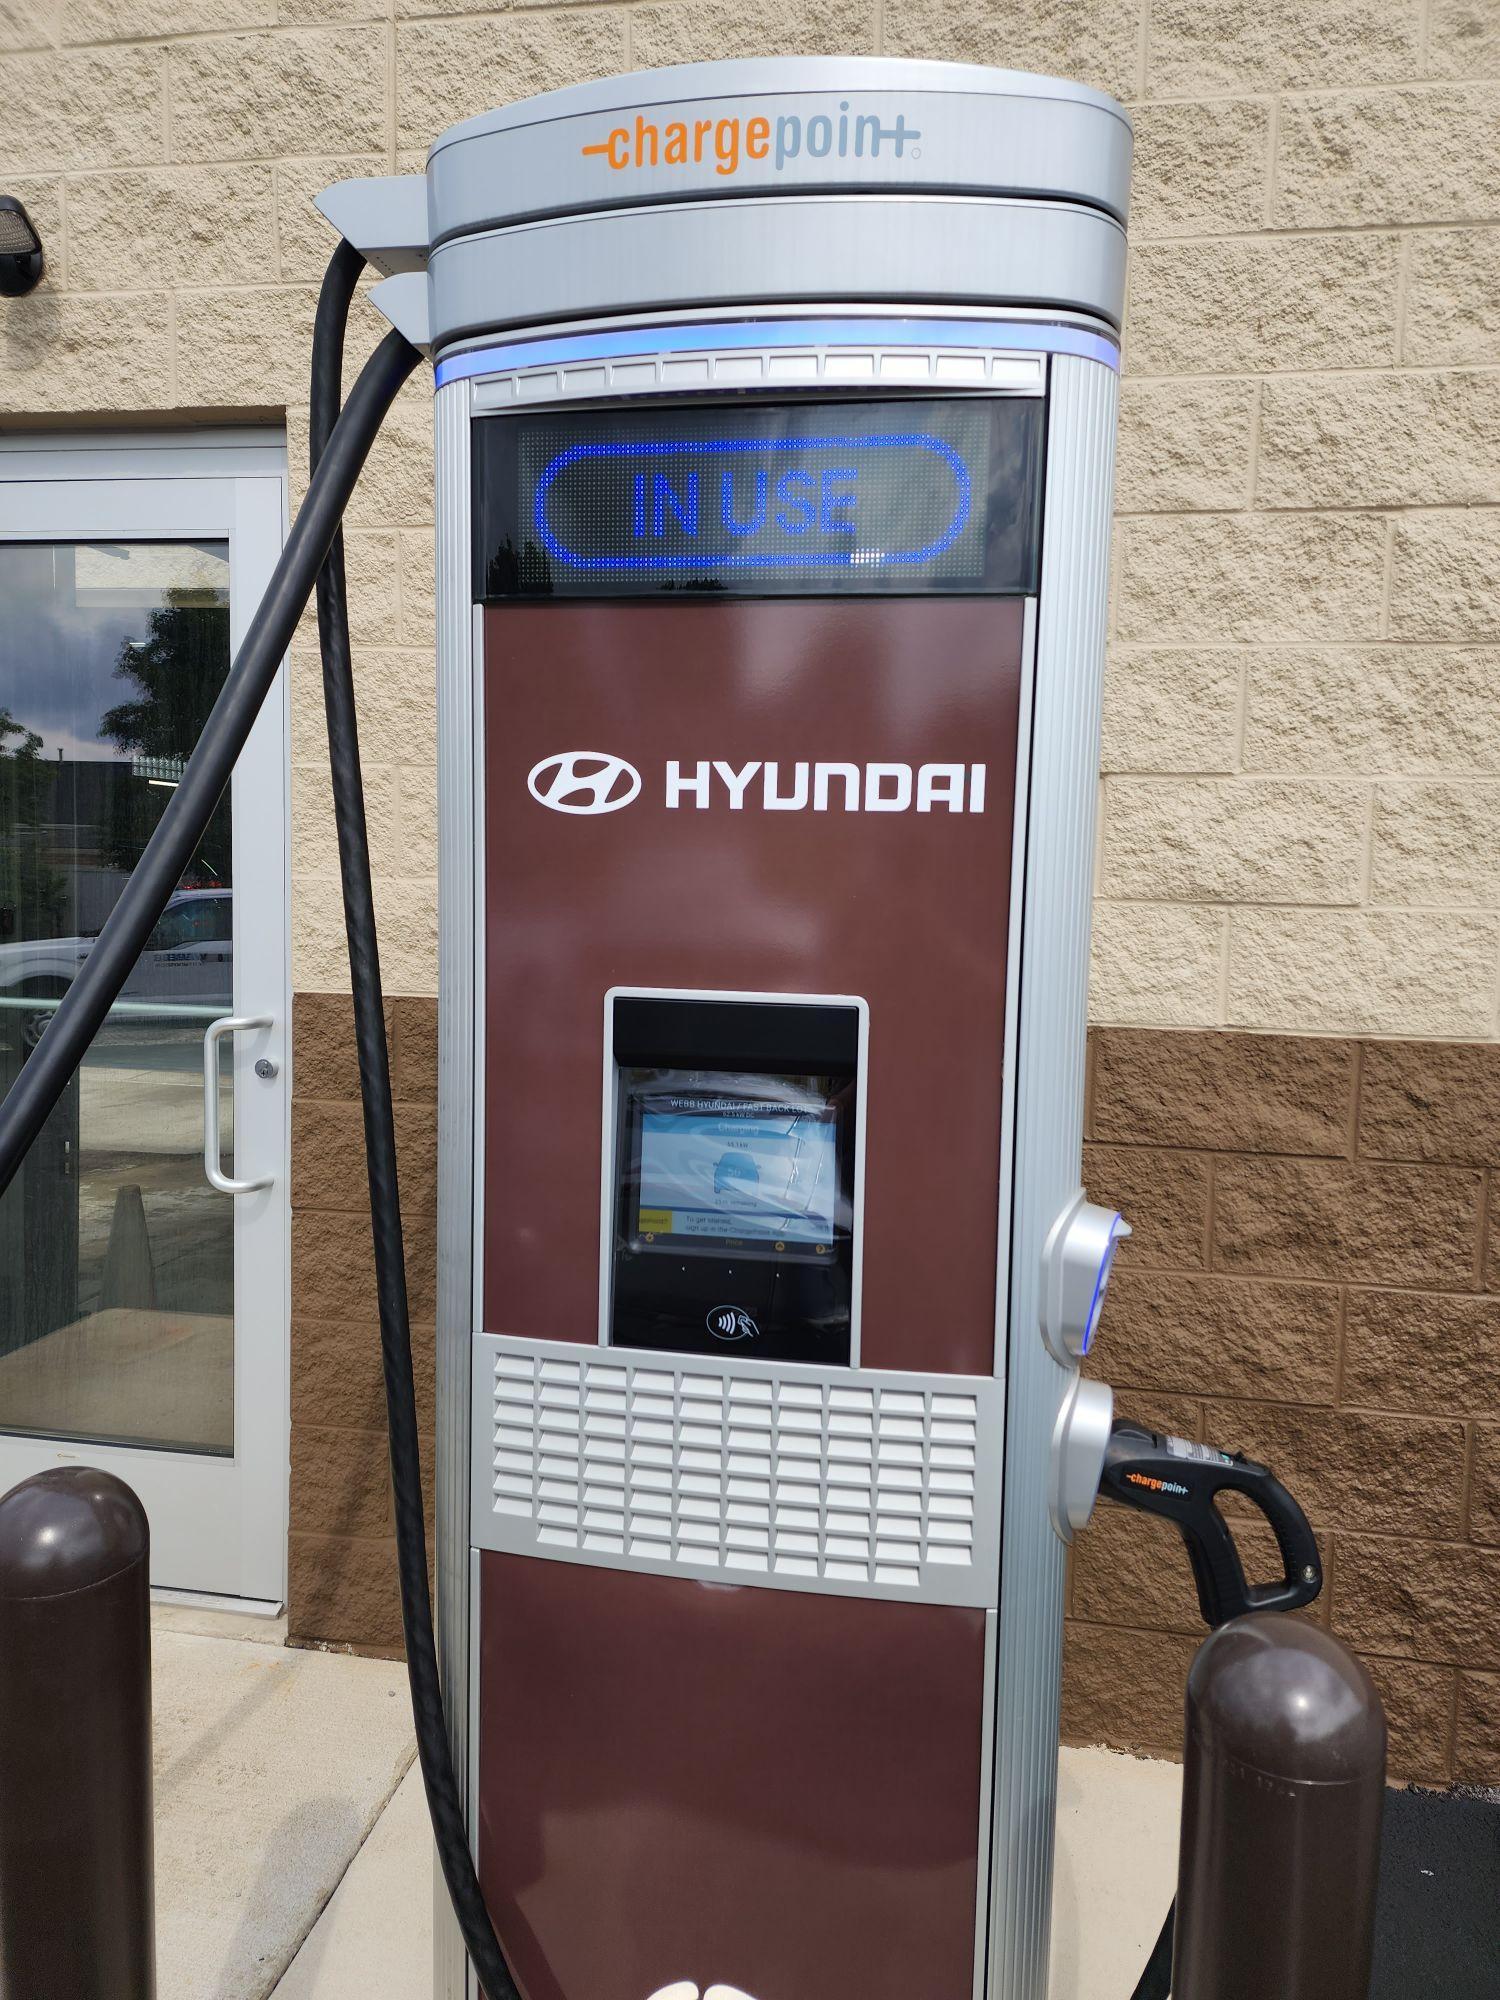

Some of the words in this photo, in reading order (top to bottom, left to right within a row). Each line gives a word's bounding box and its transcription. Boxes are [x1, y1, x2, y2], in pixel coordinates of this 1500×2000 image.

[582, 100, 922, 176] chargepoint
[633, 471, 699, 538] IN
[720, 468, 858, 535] USE
[665, 760, 987, 814] HYUNDAI
[670, 1099, 695, 1108] WEBB
[697, 1100, 735, 1110] HYUNDAI
[1126, 1473, 1188, 1495] chargepoint
